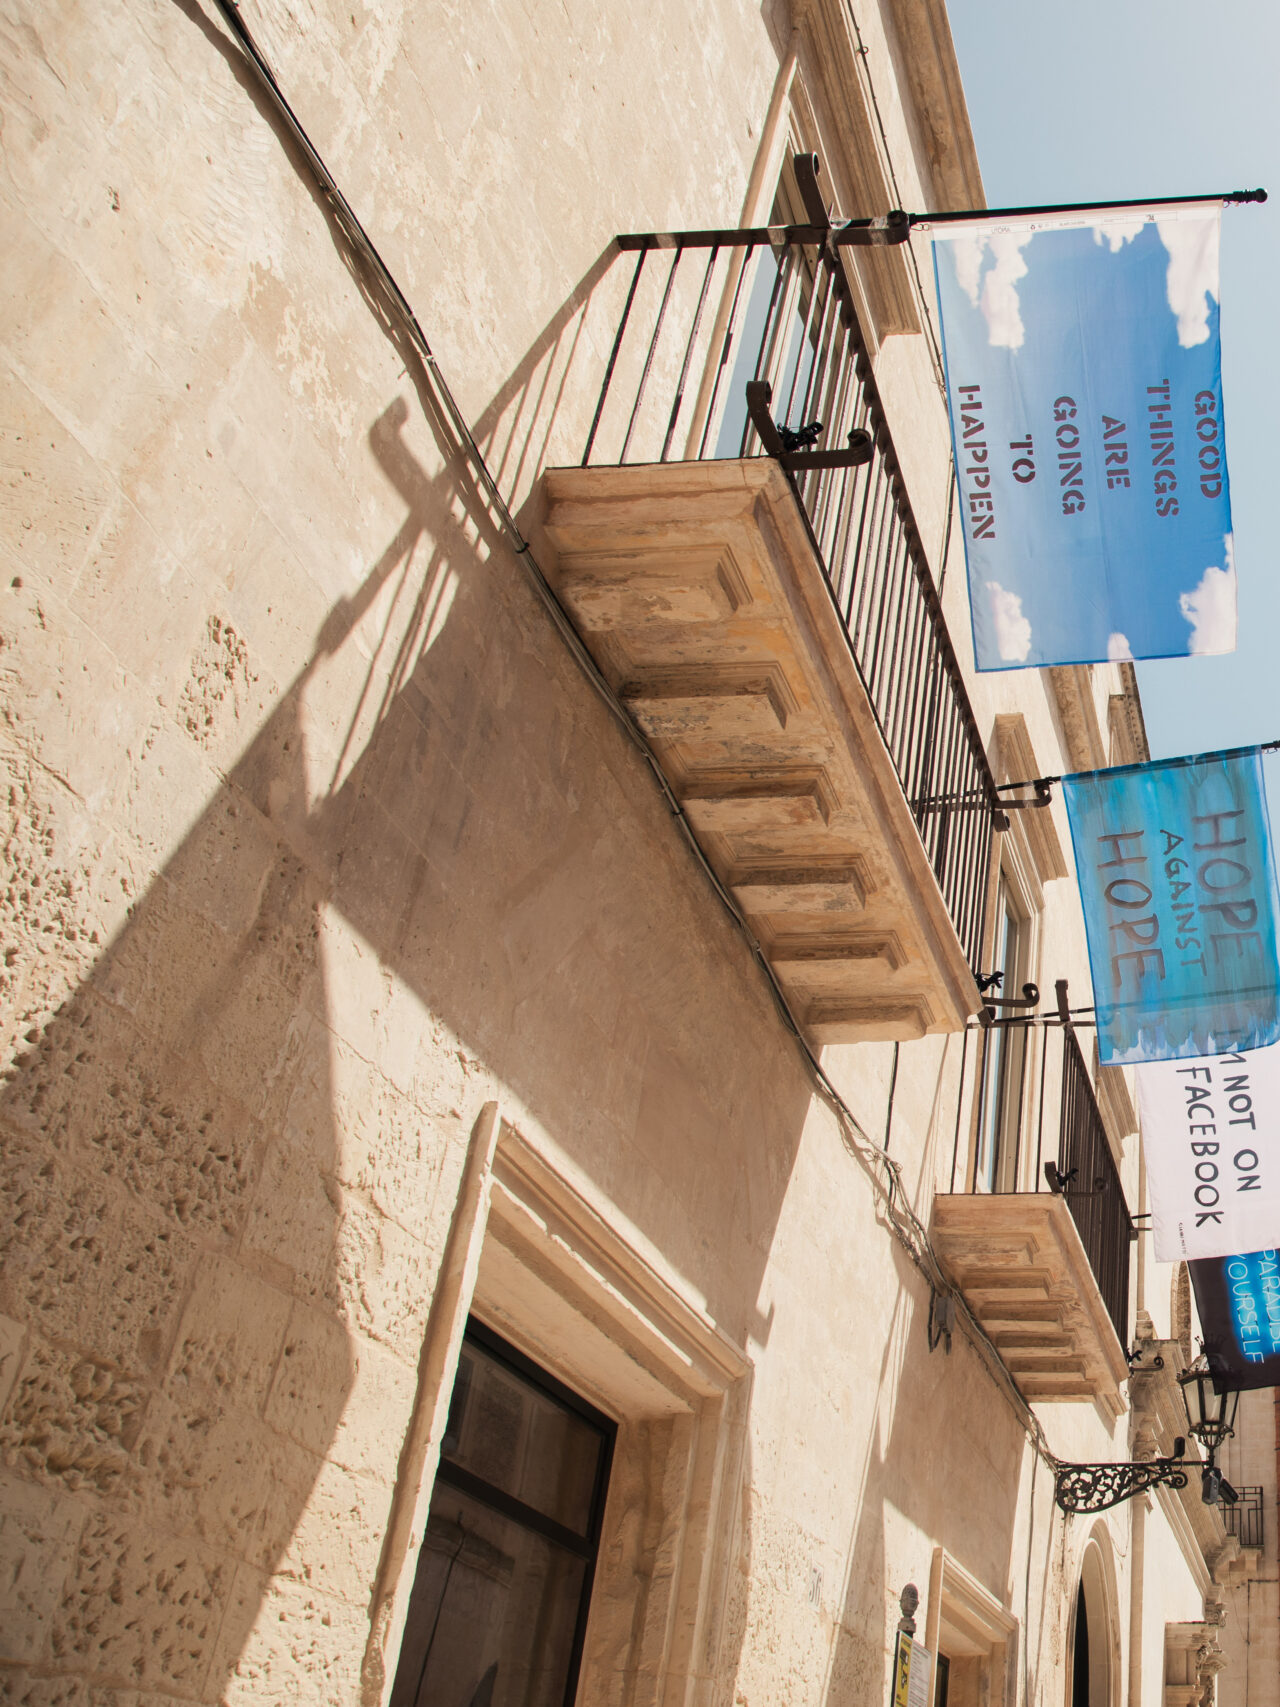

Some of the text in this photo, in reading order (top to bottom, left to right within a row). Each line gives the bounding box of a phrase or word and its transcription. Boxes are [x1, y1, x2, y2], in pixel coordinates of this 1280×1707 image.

[957, 384, 996, 540] HAPPEN
[1009, 434, 1036, 484] TO
[1053, 396, 1086, 516] GOING
[1101, 415, 1132, 490] ARE
[1146, 378, 1180, 518] THINGS
[1194, 390, 1223, 499] GOOD
[1096, 830, 1166, 987] HOPE
[1160, 829, 1208, 977] AGAINST
[1192, 809, 1264, 965] HOPE
[1176, 1066, 1225, 1228] FACEBOOK
[1223, 1074, 1256, 1131] NOT
[1233, 1149, 1262, 1192] ON
